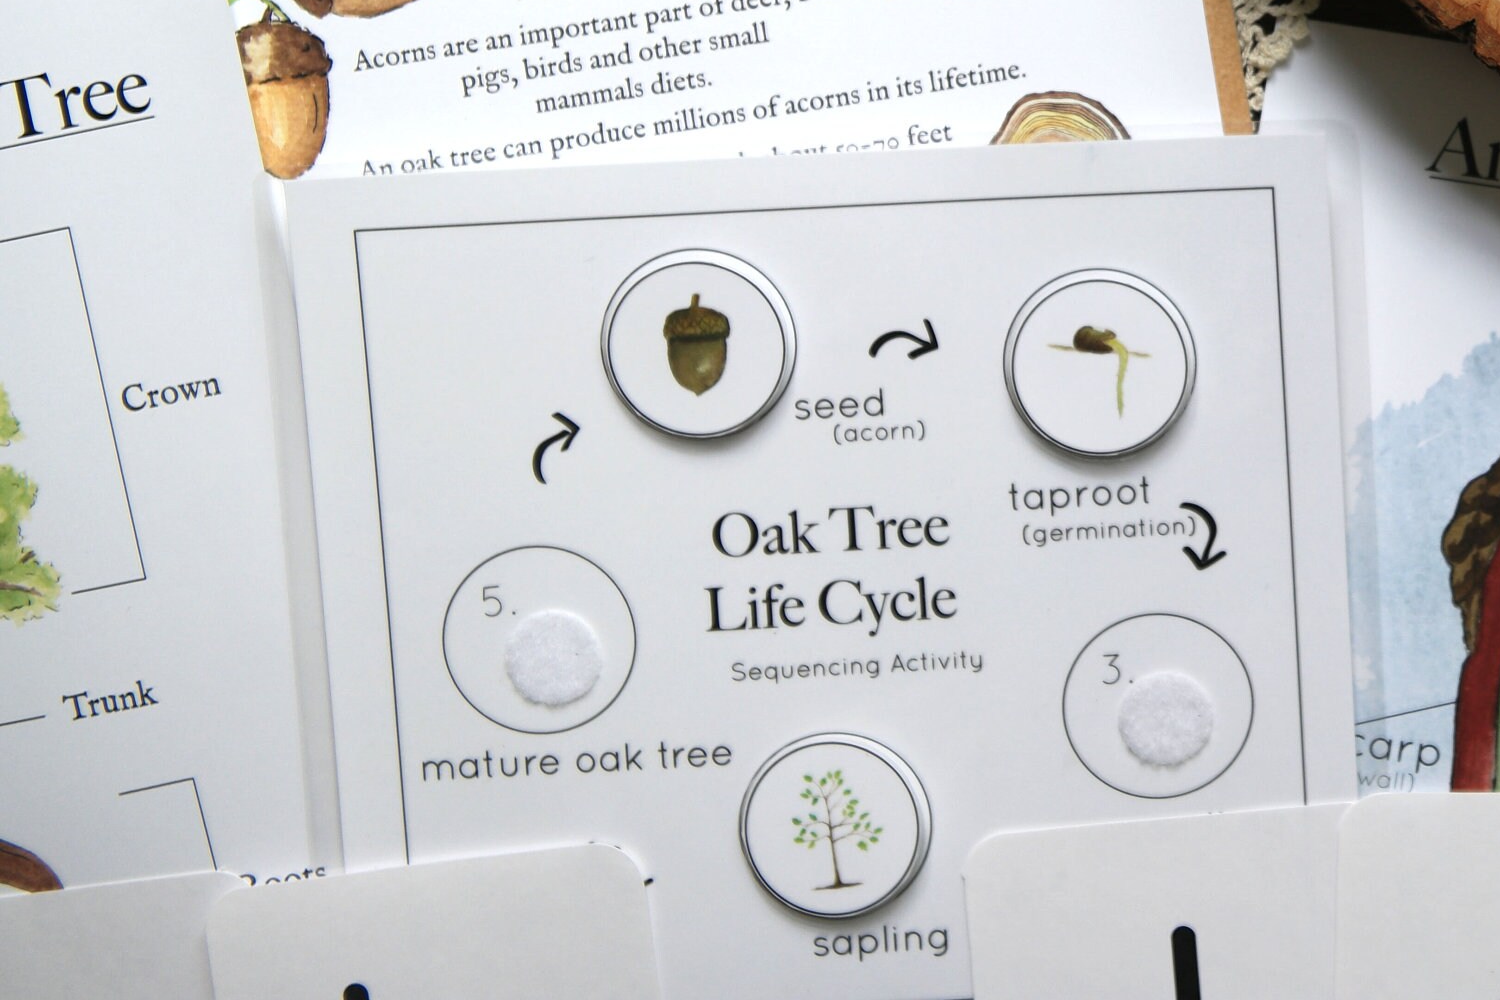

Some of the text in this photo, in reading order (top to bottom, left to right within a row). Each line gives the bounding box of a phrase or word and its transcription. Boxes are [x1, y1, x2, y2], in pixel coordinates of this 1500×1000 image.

[354, 44, 436, 72] Acorns
[443, 38, 479, 58] are
[485, 33, 513, 51] an
[519, 12, 639, 49] important
[644, 3, 693, 34] part
[461, 20, 770, 98] pigs, birds and other small
[0, 71, 151, 138] Tree
[535, 71, 713, 114] mammals diets.
[362, 63, 1027, 176] An oak tree can produce millions of acorns in its lifetime.
[907, 124, 953, 146] feet
[121, 376, 222, 412] Crown
[794, 387, 884, 420] seed
[833, 420, 926, 446] (acorn)
[1008, 476, 1149, 516] taproot
[711, 505, 950, 558] Oak Tree
[1022, 515, 1196, 547] (germination)
[482, 585, 516, 617] 5.
[704, 576, 958, 637] Life Cycle
[731, 650, 983, 684] Sequencing Activity
[1102, 654, 1134, 685] 3.
[62, 680, 159, 722] Trunk
[422, 741, 732, 781] mature oak tree
[812, 924, 950, 962] sapling
